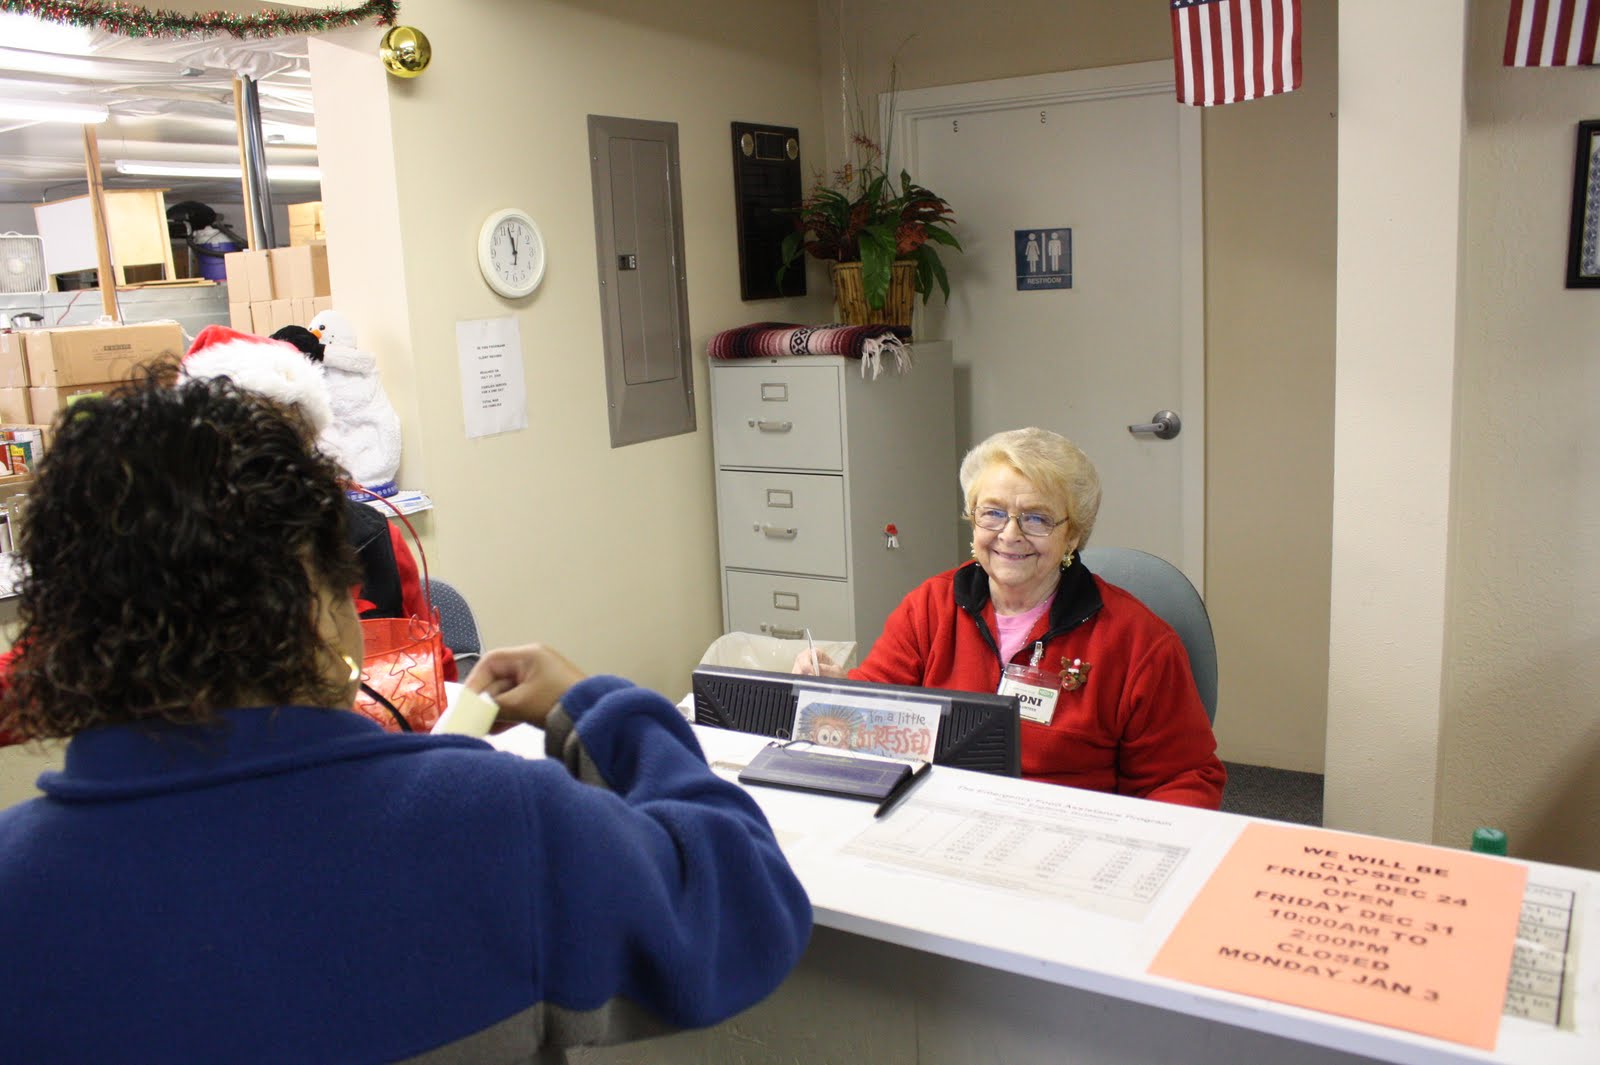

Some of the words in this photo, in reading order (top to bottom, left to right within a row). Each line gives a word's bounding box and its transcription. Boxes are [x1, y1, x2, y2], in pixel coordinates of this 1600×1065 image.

[869, 711, 884, 723] I'm
[887, 713, 894, 721] a
[898, 712, 926, 725] little
[857, 724, 932, 755] STRESSED
[1304, 846, 1338, 858] WE
[1348, 854, 1406, 870] WILL
[1416, 866, 1450, 877] BE
[1320, 861, 1421, 884] CLOSED
[1266, 865, 1357, 886] FRIDAY
[1375, 884, 1427, 899] DEC
[1437, 895, 1468, 907] 24
[1323, 888, 1394, 908] OPEN
[1254, 890, 1350, 914] FRIDAY
[1360, 910, 1413, 927] DEC
[1425, 923, 1455, 935] 31
[1270, 909, 1380, 936] 10:00AM
[1392, 932, 1428, 946] TO
[1277, 943, 1390, 971] CLOSED
[1291, 928, 1390, 955] 2:00PM
[1219, 947, 1342, 978] MONDAY
[1353, 975, 1412, 995] JAN
[1425, 991, 1440, 1001] 3
